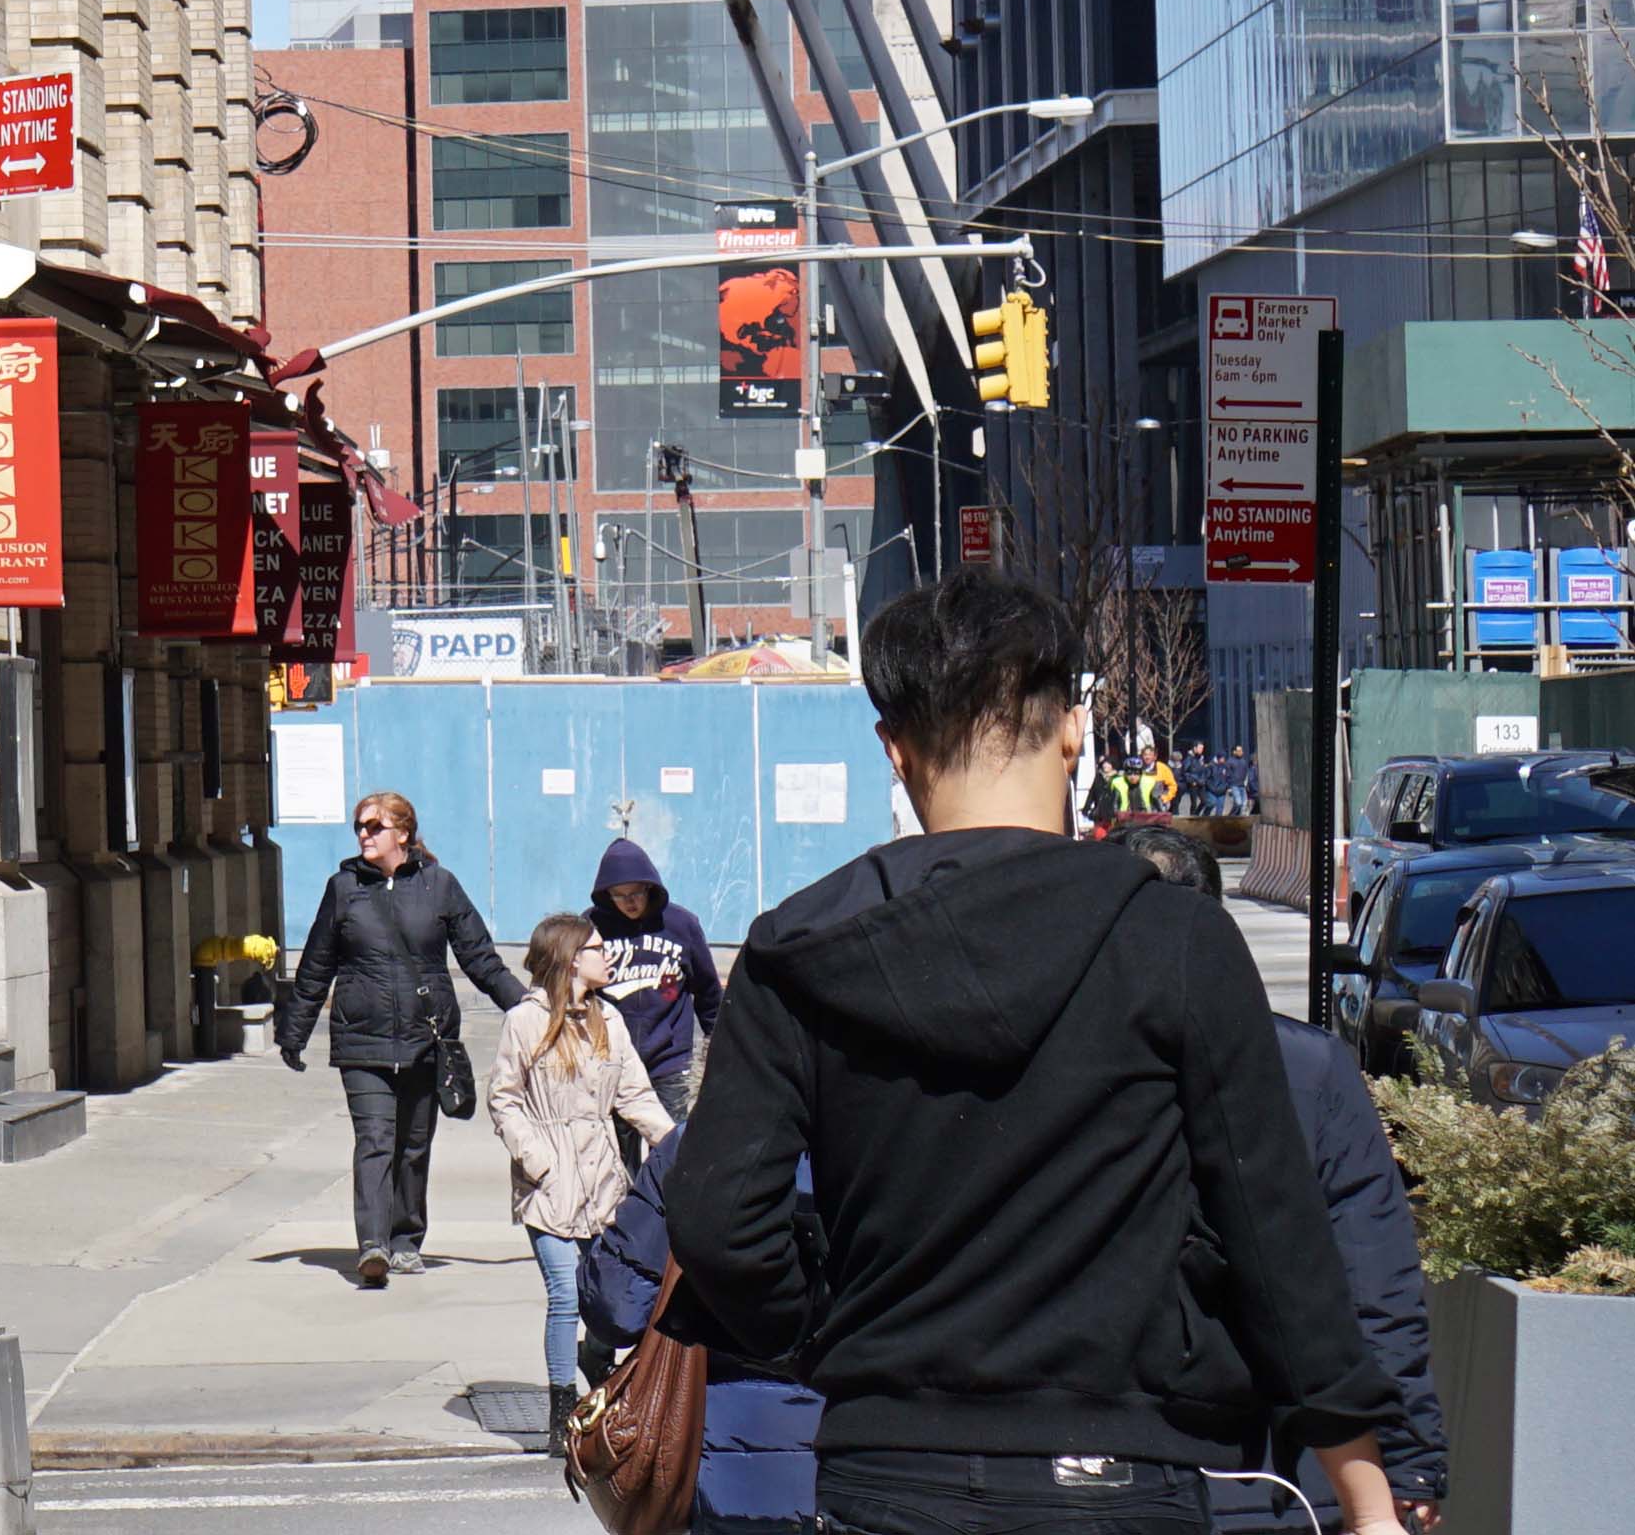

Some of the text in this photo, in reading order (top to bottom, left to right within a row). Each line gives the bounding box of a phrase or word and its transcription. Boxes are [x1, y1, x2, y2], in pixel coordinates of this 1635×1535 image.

[2, 83, 68, 116] STANDING
[718, 230, 798, 249] financial
[1257, 301, 1309, 315] Farmers
[1257, 316, 1302, 329] Market
[1257, 328, 1286, 344] Only
[1214, 353, 1262, 369] Tuesday
[1214, 368, 1241, 382] 6am
[1251, 368, 1278, 385] 6pm
[748, 383, 775, 403] bgc
[1217, 427, 1310, 444] NO PARKING
[1217, 446, 1280, 465] Anytime
[249, 456, 278, 479] UE
[251, 492, 290, 515] NET
[301, 503, 334, 522] LUE
[173, 456, 218, 583] KOKO
[1212, 506, 1312, 525] NO STANDING
[301, 534, 344, 553] ANET
[1213, 526, 1275, 545] Anytime
[300, 566, 340, 582] RICK
[301, 586, 337, 602] VEN
[304, 613, 339, 629] ZZA
[430, 632, 517, 657] PAPD
[1493, 723, 1521, 741] 133
[642, 933, 683, 962] DEPT.
